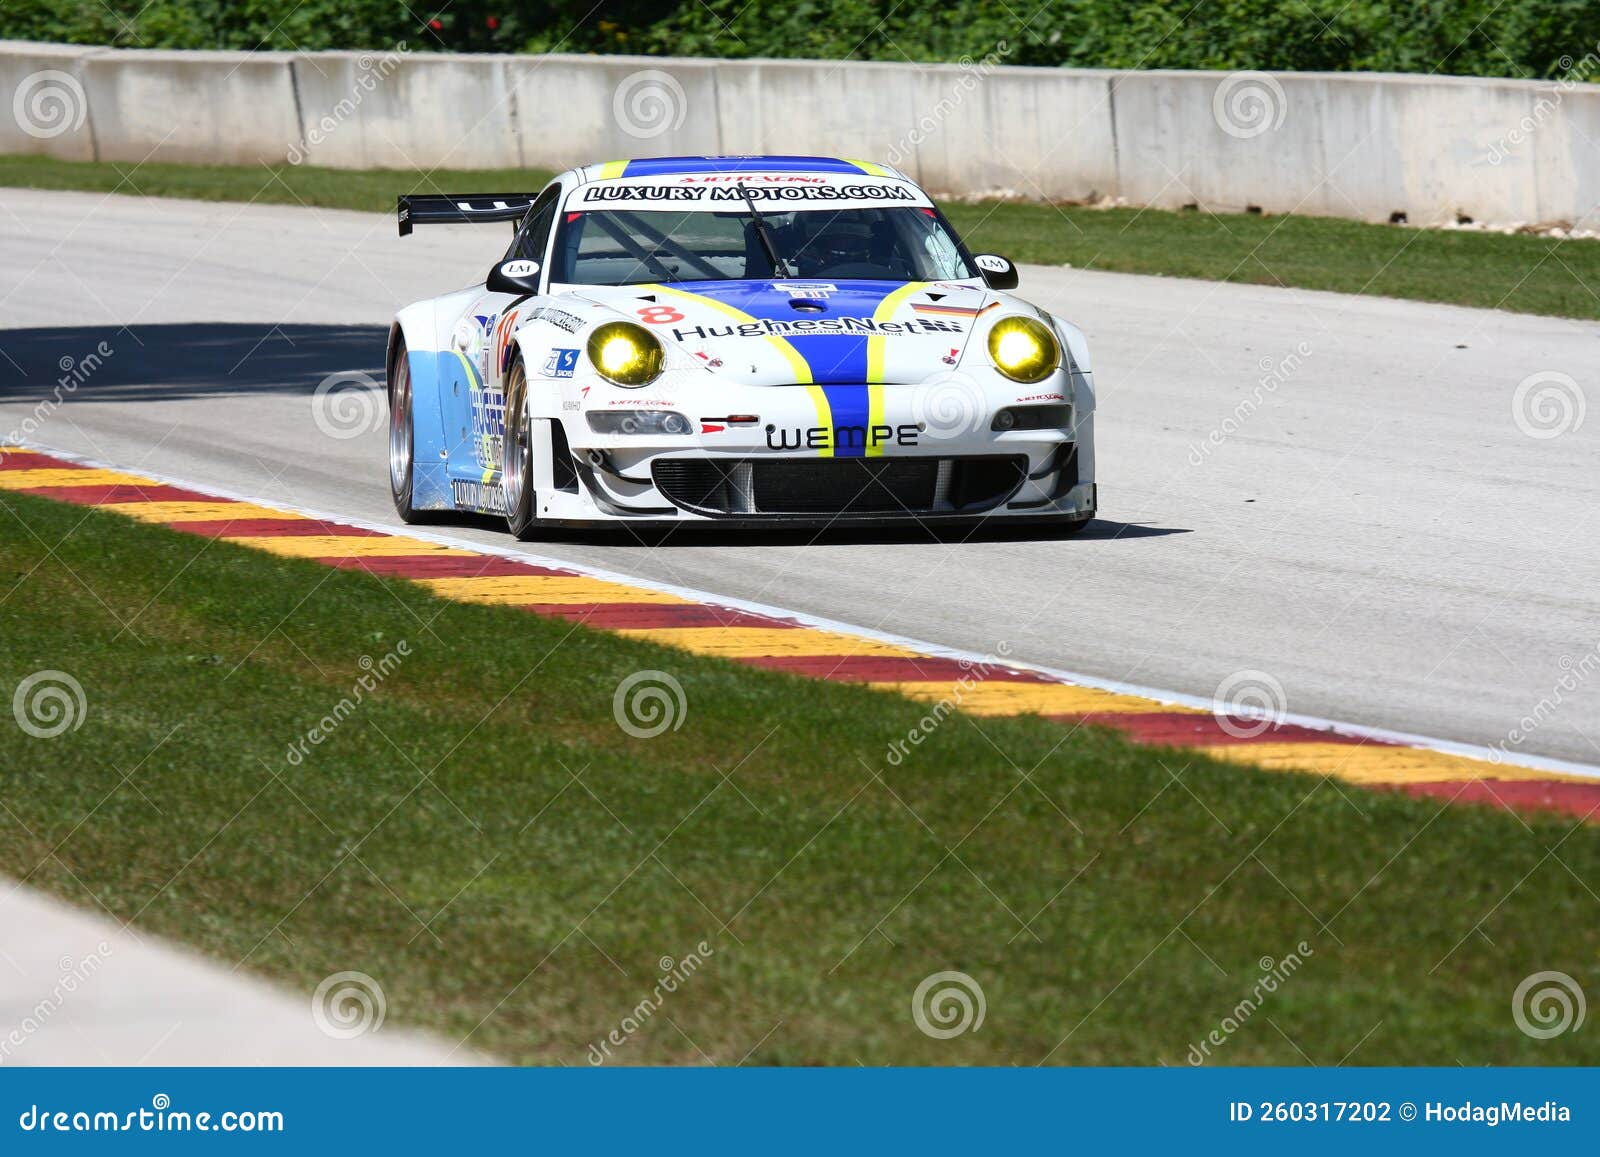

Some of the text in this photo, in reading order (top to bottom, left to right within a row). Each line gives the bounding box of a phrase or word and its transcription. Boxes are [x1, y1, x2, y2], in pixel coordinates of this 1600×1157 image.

[584, 185, 916, 202] LUXURY MOTORS.COM
[636, 306, 685, 325] 8
[672, 318, 922, 342] HughesNet
